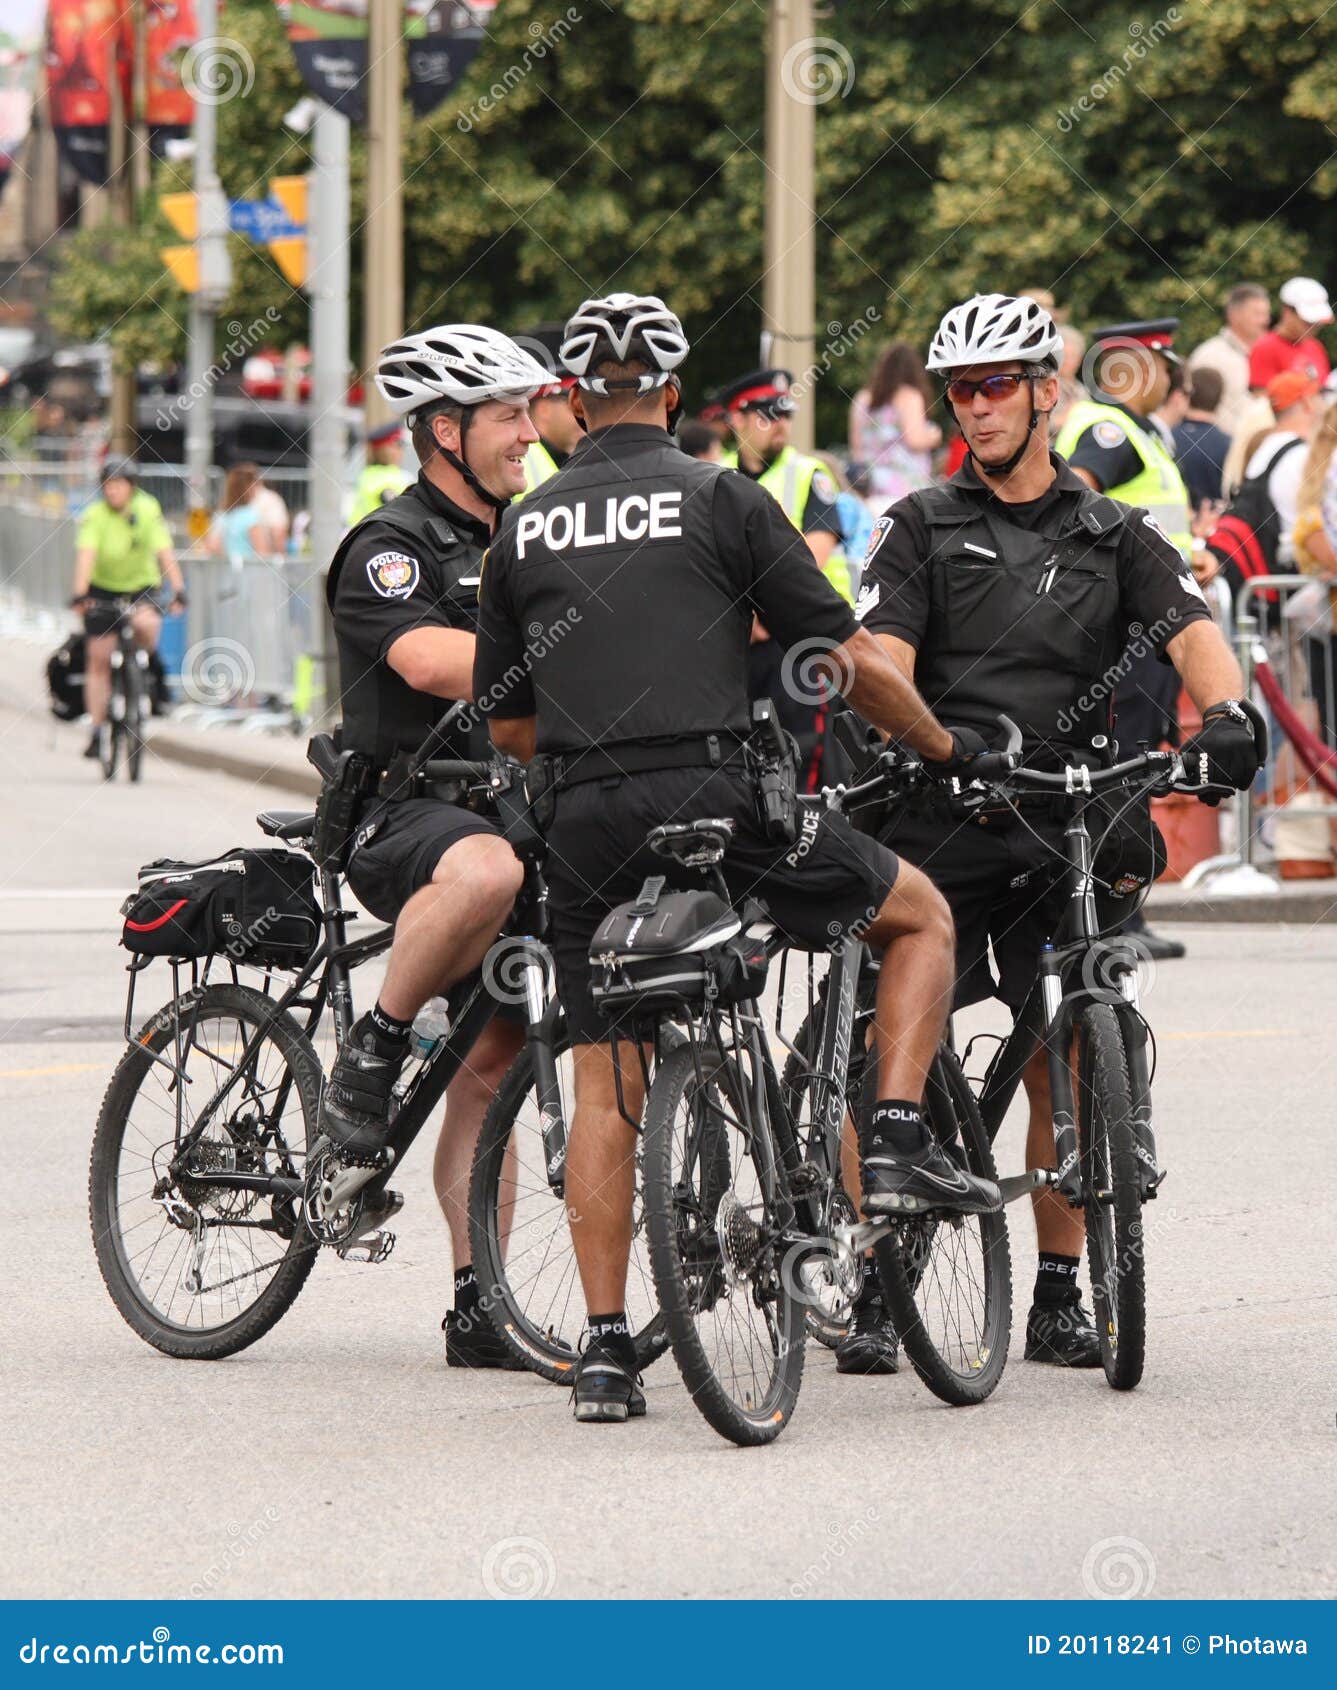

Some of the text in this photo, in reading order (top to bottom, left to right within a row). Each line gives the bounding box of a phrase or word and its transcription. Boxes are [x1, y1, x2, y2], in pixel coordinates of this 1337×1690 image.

[516, 491, 682, 561] POLICE
[371, 554, 410, 570] POLICE
[786, 810, 820, 868] POLICE
